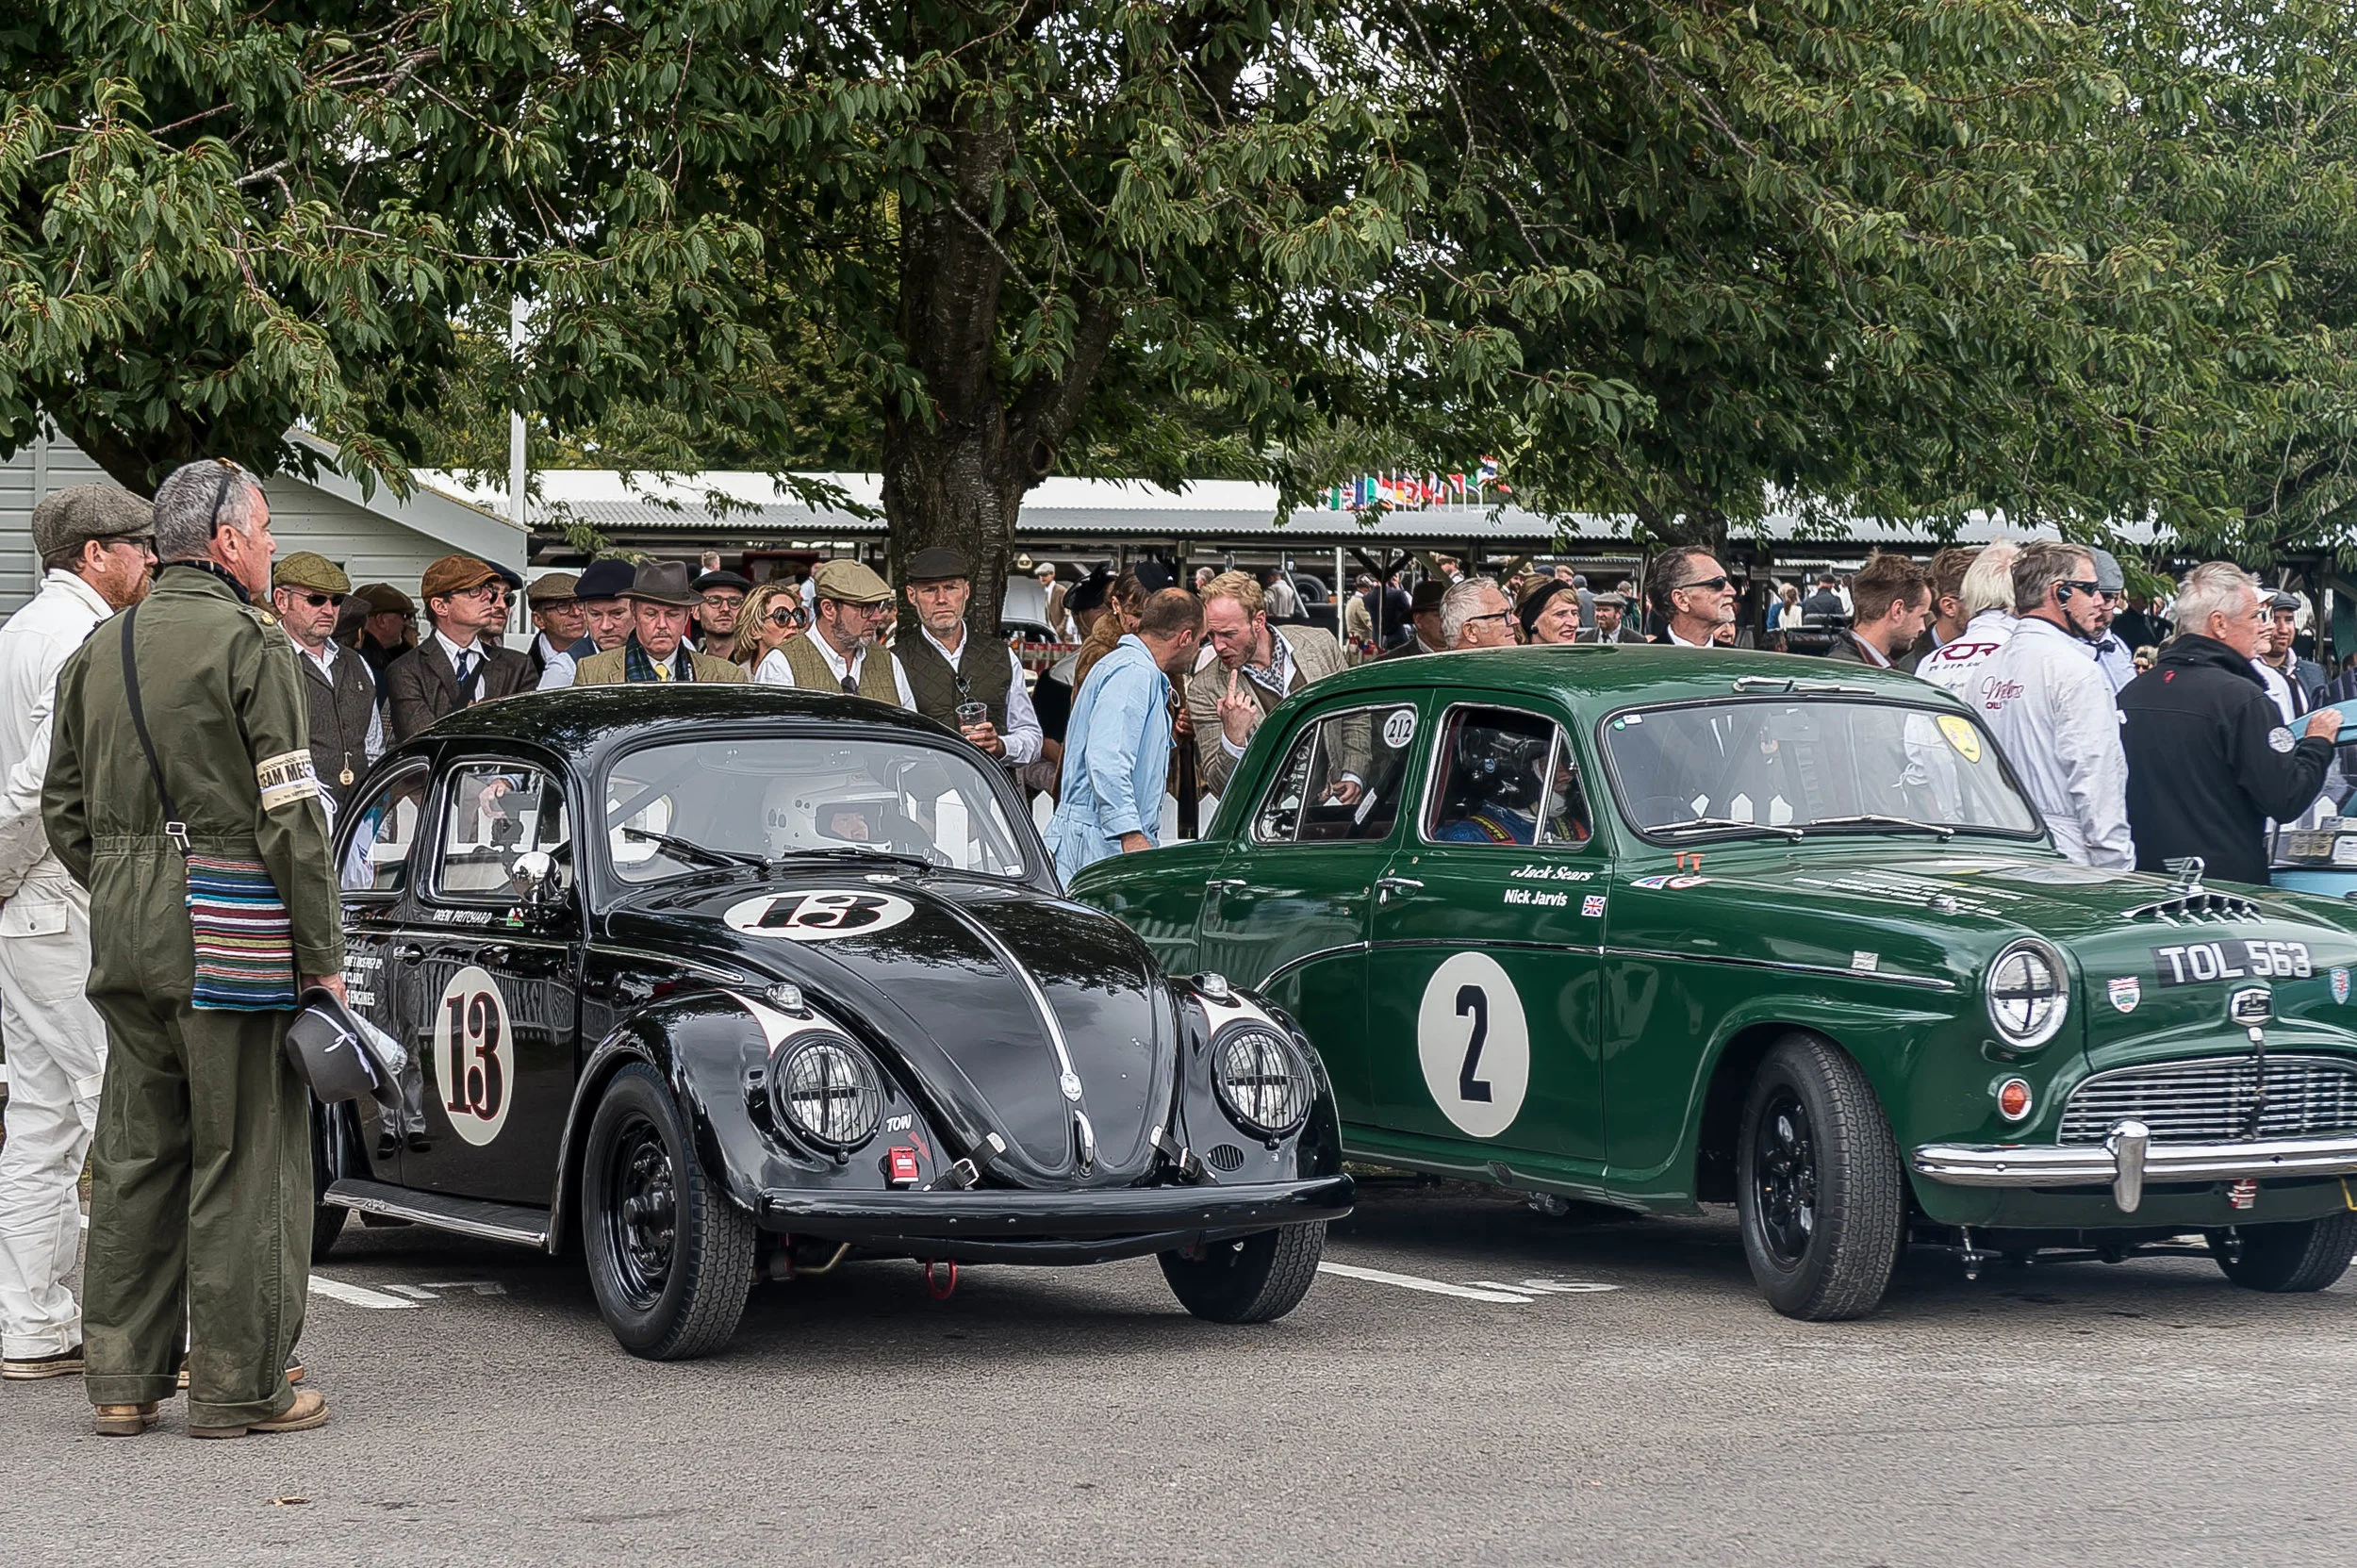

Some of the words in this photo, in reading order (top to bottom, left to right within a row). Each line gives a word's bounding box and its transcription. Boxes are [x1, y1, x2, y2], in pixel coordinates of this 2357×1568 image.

[1388, 718, 1412, 737] 212
[1510, 864, 1555, 879] Jack
[1553, 866, 1595, 882] Sears
[1504, 889, 1530, 905] Nick
[1531, 891, 1569, 907] Jarvis
[742, 895, 890, 930] 13
[2158, 943, 2245, 983] TOL
[2244, 940, 2313, 979] 563
[350, 989, 375, 1007] ENGINES
[1455, 983, 1493, 1103] 2
[446, 991, 503, 1121] 13
[886, 1114, 912, 1132] TOW
